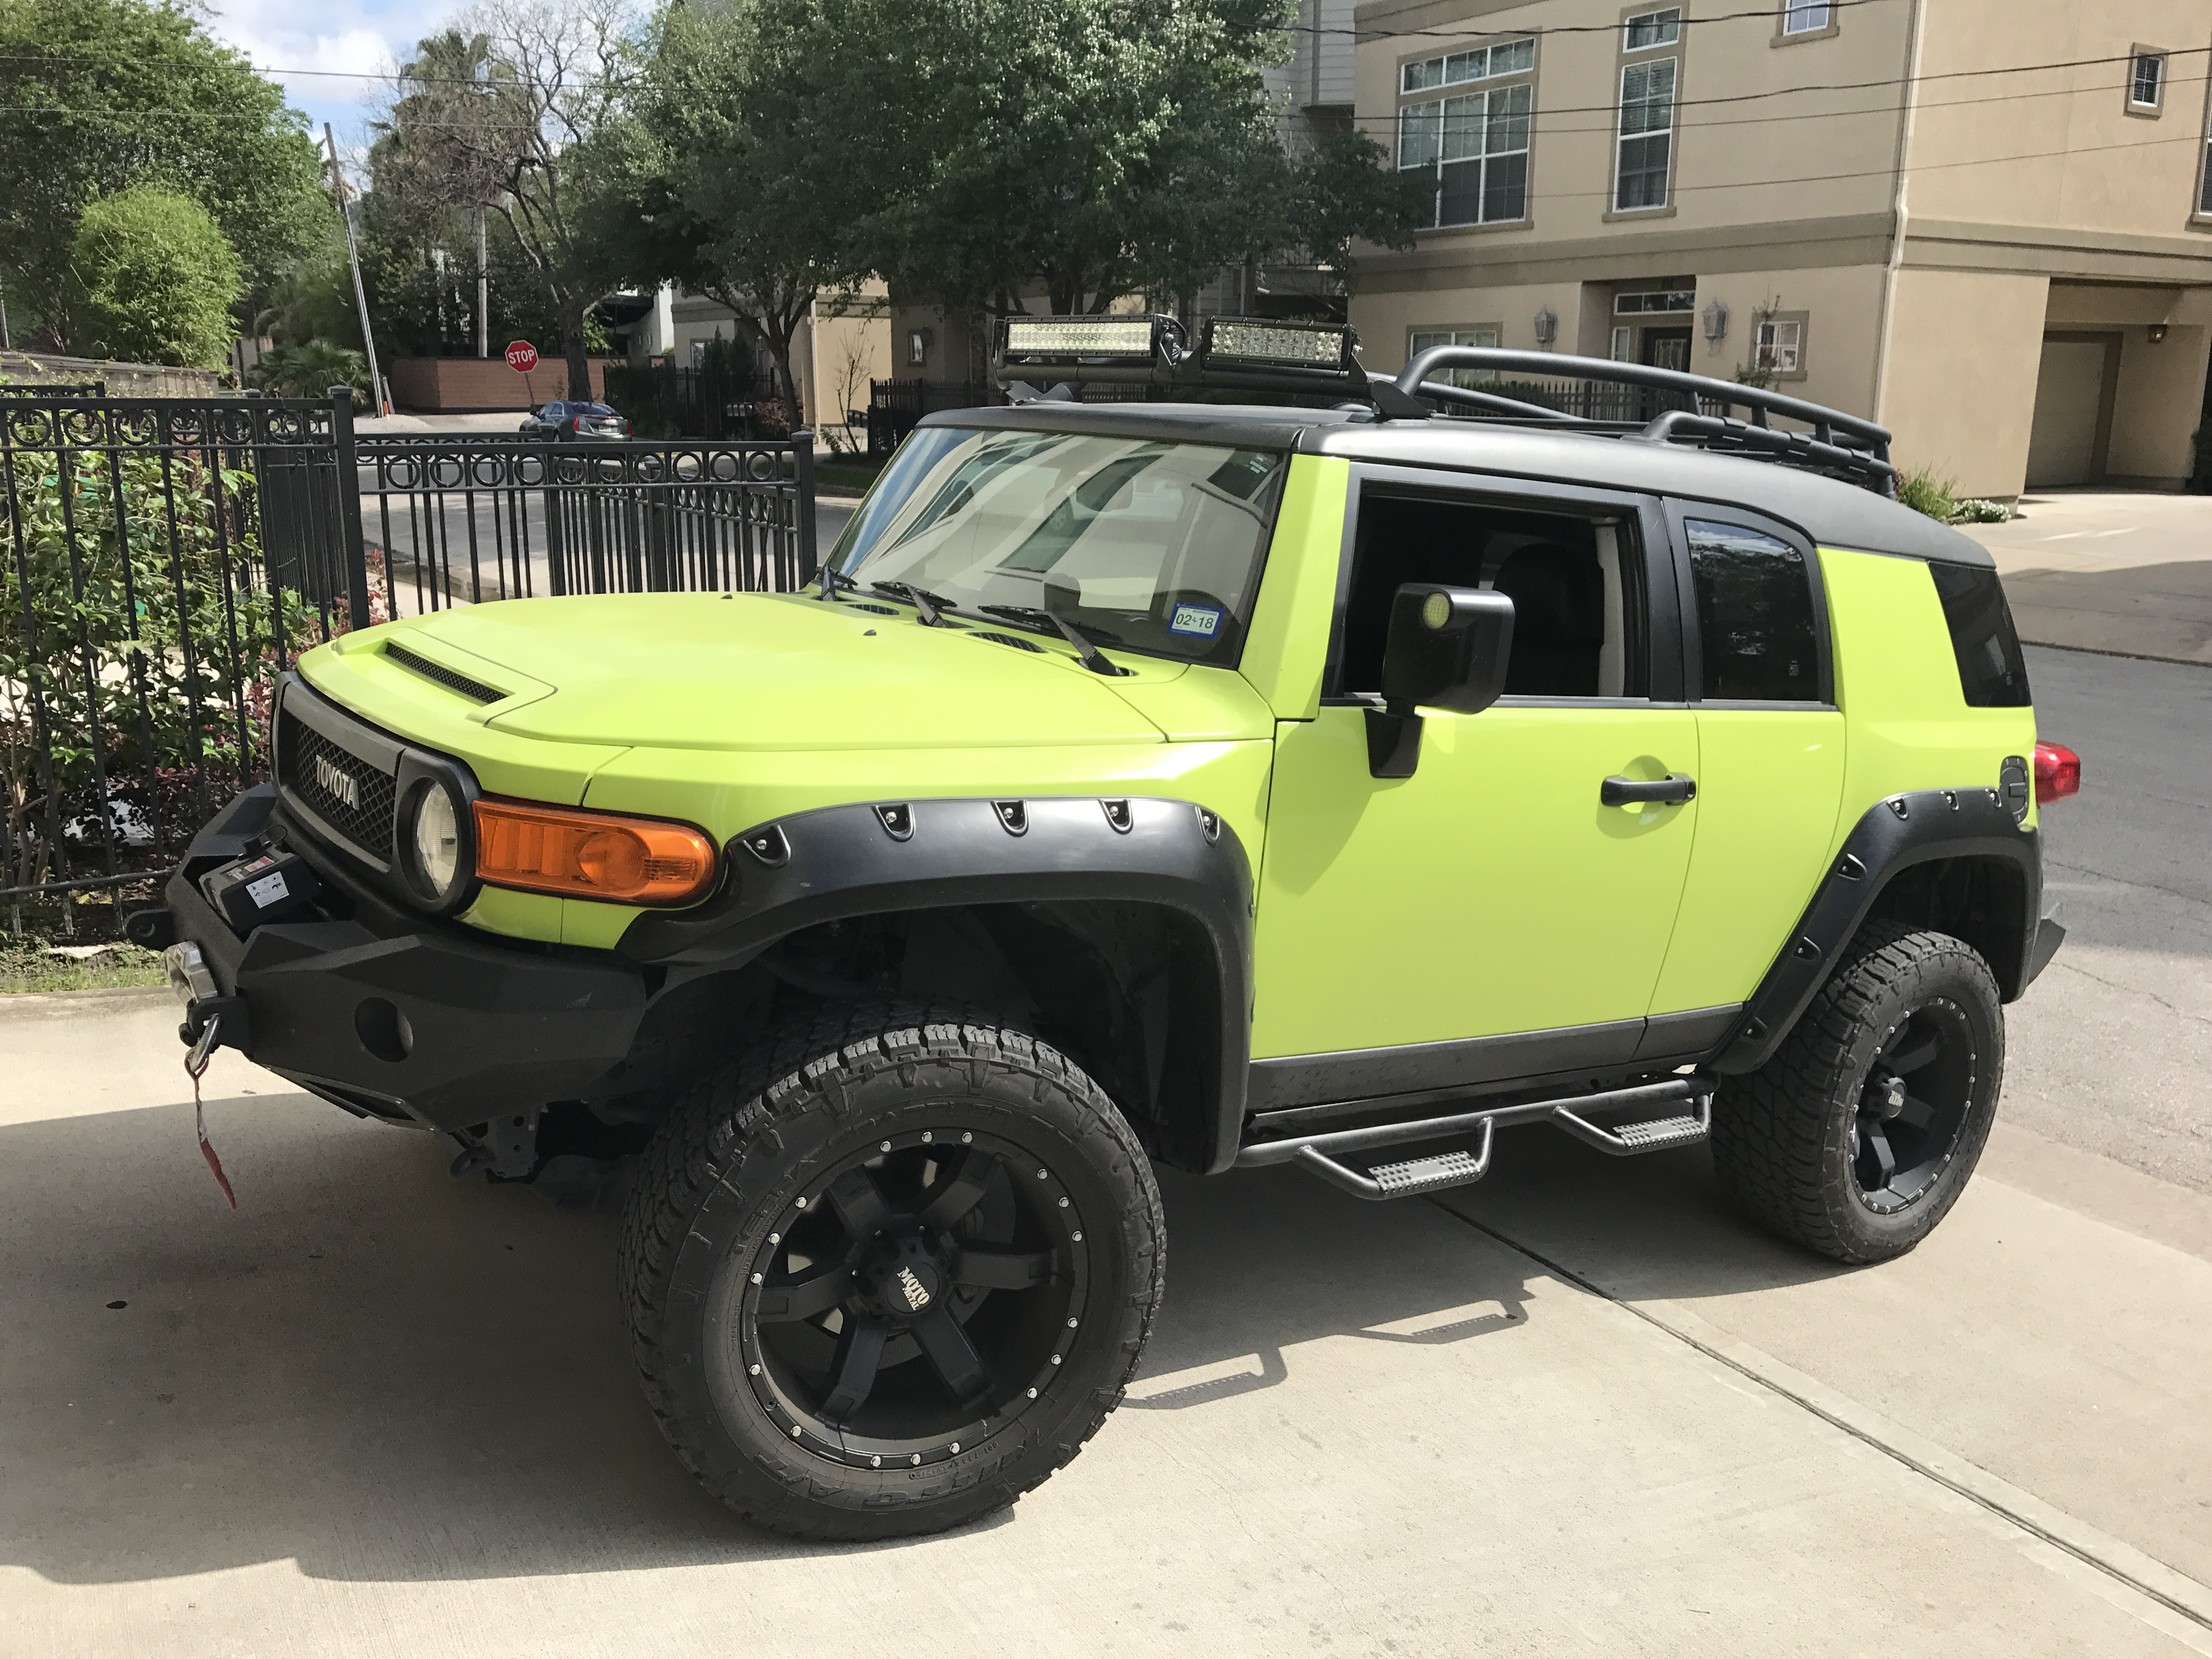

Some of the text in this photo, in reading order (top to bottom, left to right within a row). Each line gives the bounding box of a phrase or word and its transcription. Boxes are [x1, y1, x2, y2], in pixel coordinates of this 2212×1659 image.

[508, 349, 535, 364] STOP
[1176, 613, 1214, 629] 02 18
[316, 754, 359, 810] TOYOTA
[896, 1266, 930, 1305] MOTO
[902, 1288, 919, 1311] METAL
